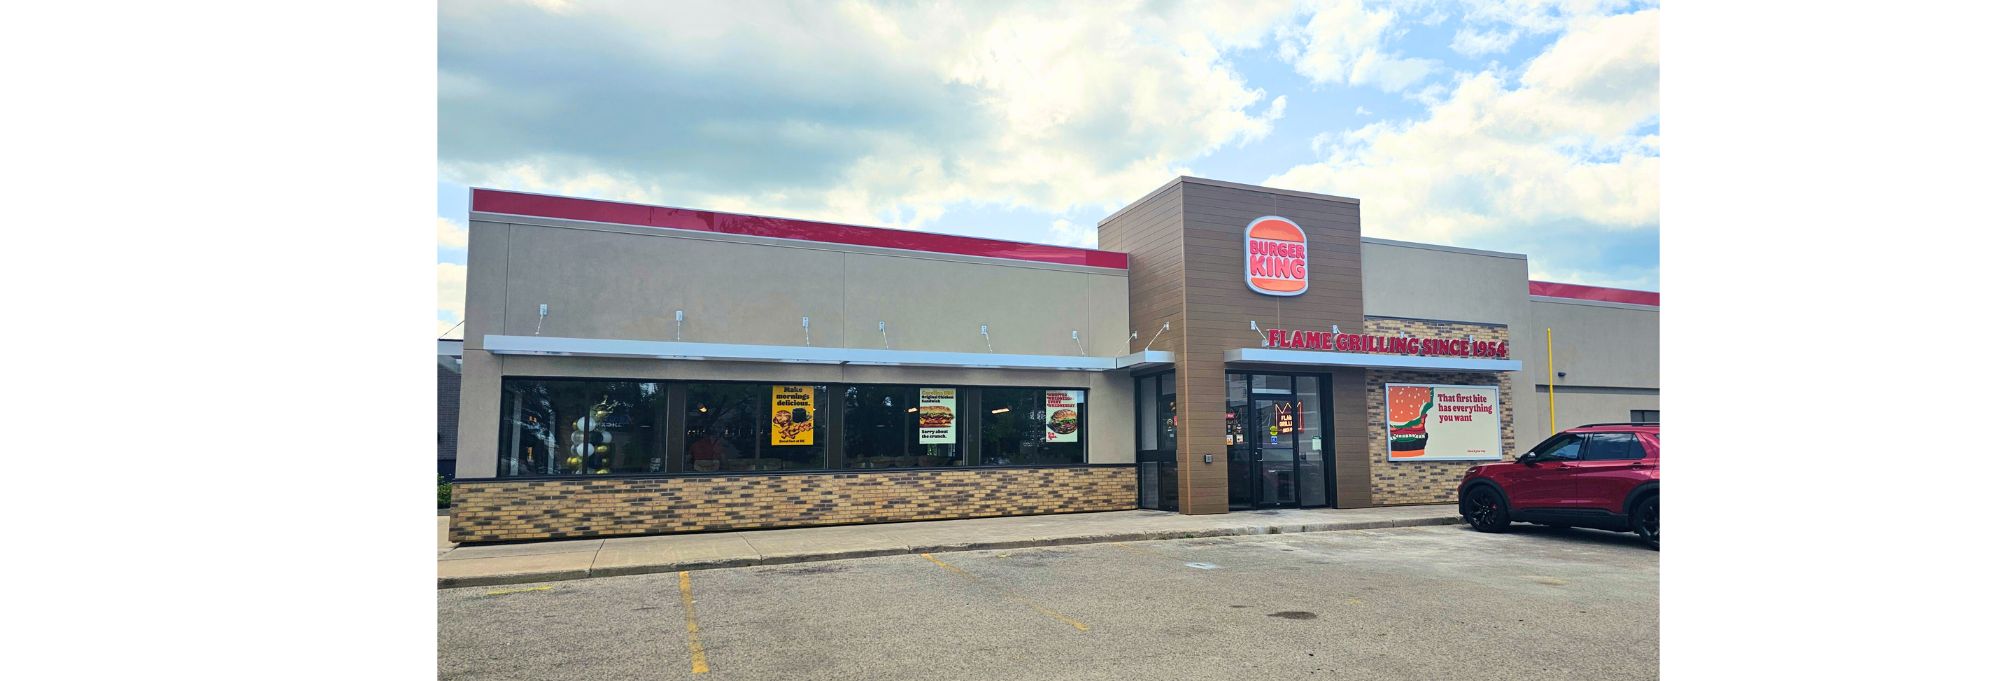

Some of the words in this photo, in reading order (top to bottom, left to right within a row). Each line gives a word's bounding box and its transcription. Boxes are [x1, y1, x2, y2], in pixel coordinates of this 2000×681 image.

[1250, 240, 1305, 259] BURGER
[1250, 255, 1305, 279] KING
[1267, 329, 1333, 350] FLAME
[1336, 333, 1420, 355] GRILLING
[1423, 338, 1470, 356] SINCE
[1473, 340, 1507, 357] 1954
[1438, 394, 1455, 402] That
[1456, 393, 1472, 402] first
[1473, 394, 1487, 402] bite
[1438, 403, 1451, 411] has
[1452, 404, 1493, 414] everything
[1439, 415, 1453, 423] you
